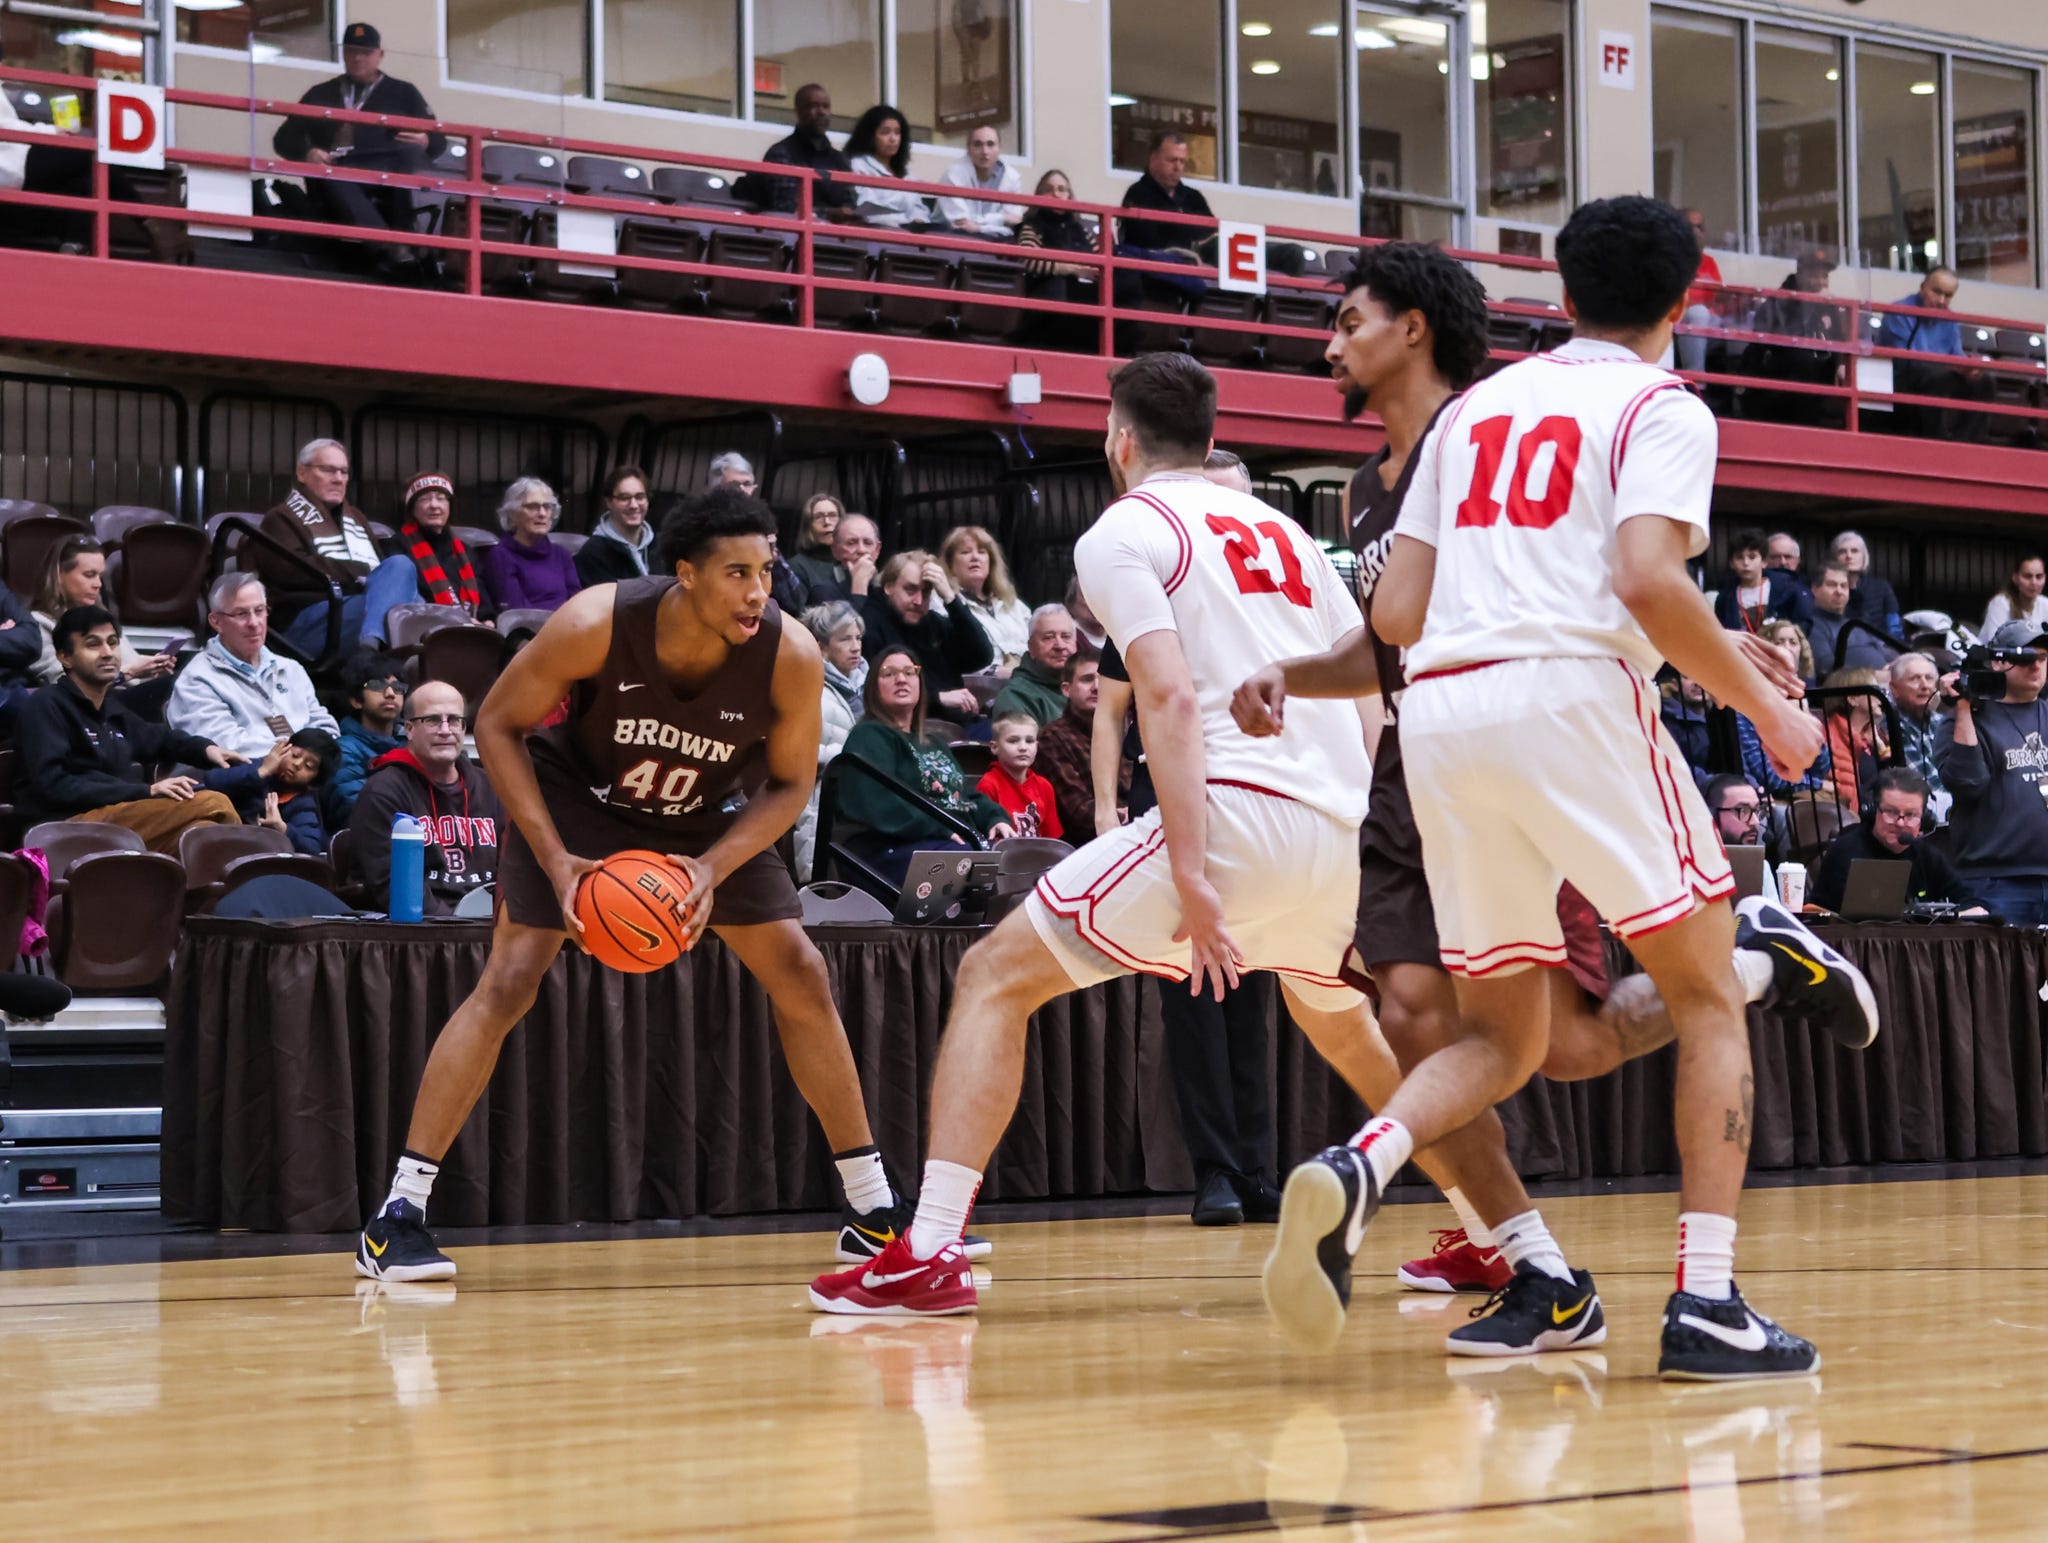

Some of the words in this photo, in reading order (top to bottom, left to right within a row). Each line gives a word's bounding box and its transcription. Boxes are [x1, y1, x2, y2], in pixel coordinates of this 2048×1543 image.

[1604, 45, 1629, 74] FF
[109, 94, 156, 153] D
[1229, 233, 1257, 282] E
[1455, 415, 1583, 529] 10
[1205, 513, 1313, 608] 21
[720, 711, 736, 722] Ivy
[614, 718, 736, 762] BROWN
[619, 758, 702, 802] 40
[428, 870, 493, 883] BEARS
